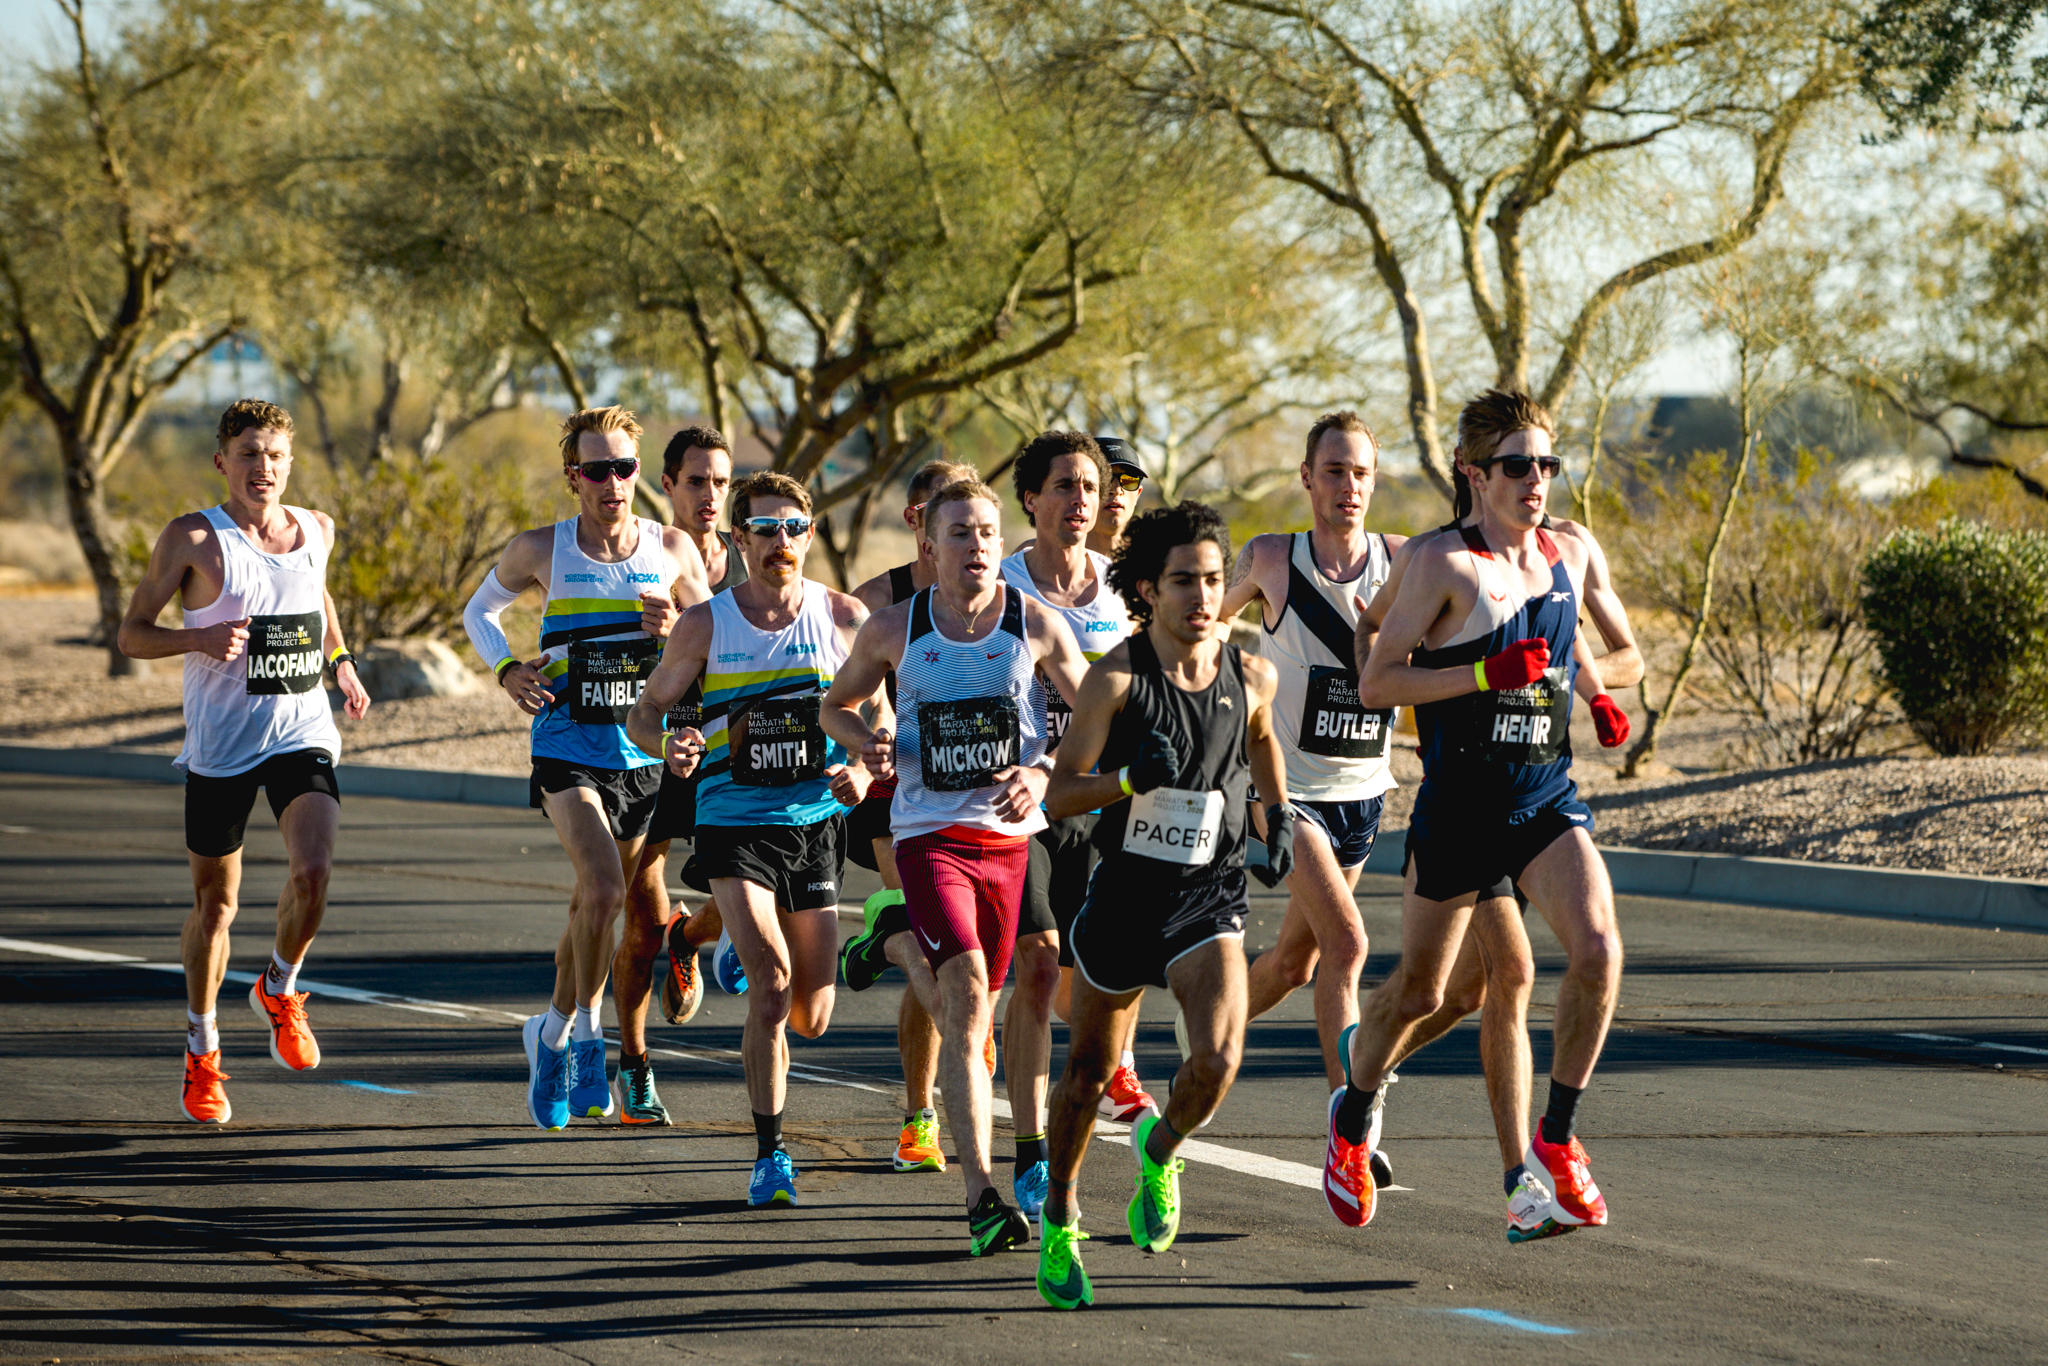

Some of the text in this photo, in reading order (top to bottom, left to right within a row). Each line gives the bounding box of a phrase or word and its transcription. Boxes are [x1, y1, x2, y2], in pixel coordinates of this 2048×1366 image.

[626, 573, 660, 583] HOKA
[267, 624, 282, 632] THE
[1085, 620, 1118, 632] HOKA
[266, 630, 308, 639] MARATHON
[266, 637, 312, 647] PROJECT 2020
[588, 651, 604, 659] THE
[248, 649, 322, 679] IACOFANO
[587, 657, 634, 666] MARATHON
[587, 665, 640, 674] PROJECT 2020
[1330, 678, 1348, 688] THE
[581, 679, 647, 707] FAUBLE
[1328, 686, 1359, 697] MARAT
[1499, 688, 1548, 698] MARATHON
[1497, 696, 1554, 706] PROJECT 2020
[748, 712, 765, 720] THE
[748, 717, 798, 728] MARATHON
[939, 717, 991, 729] MARATHON
[1314, 709, 1381, 740] BUTLER
[748, 725, 806, 736] PROJECT 2020
[939, 725, 998, 737] PROJECT 2020
[1491, 713, 1552, 744] HEHIR
[750, 740, 808, 770] SMITH
[930, 739, 1011, 773] MICKOW
[1152, 802, 1204, 814] PROJECT 2020
[1132, 819, 1211, 848] PACER
[570, 1052, 579, 1091] HOKA
